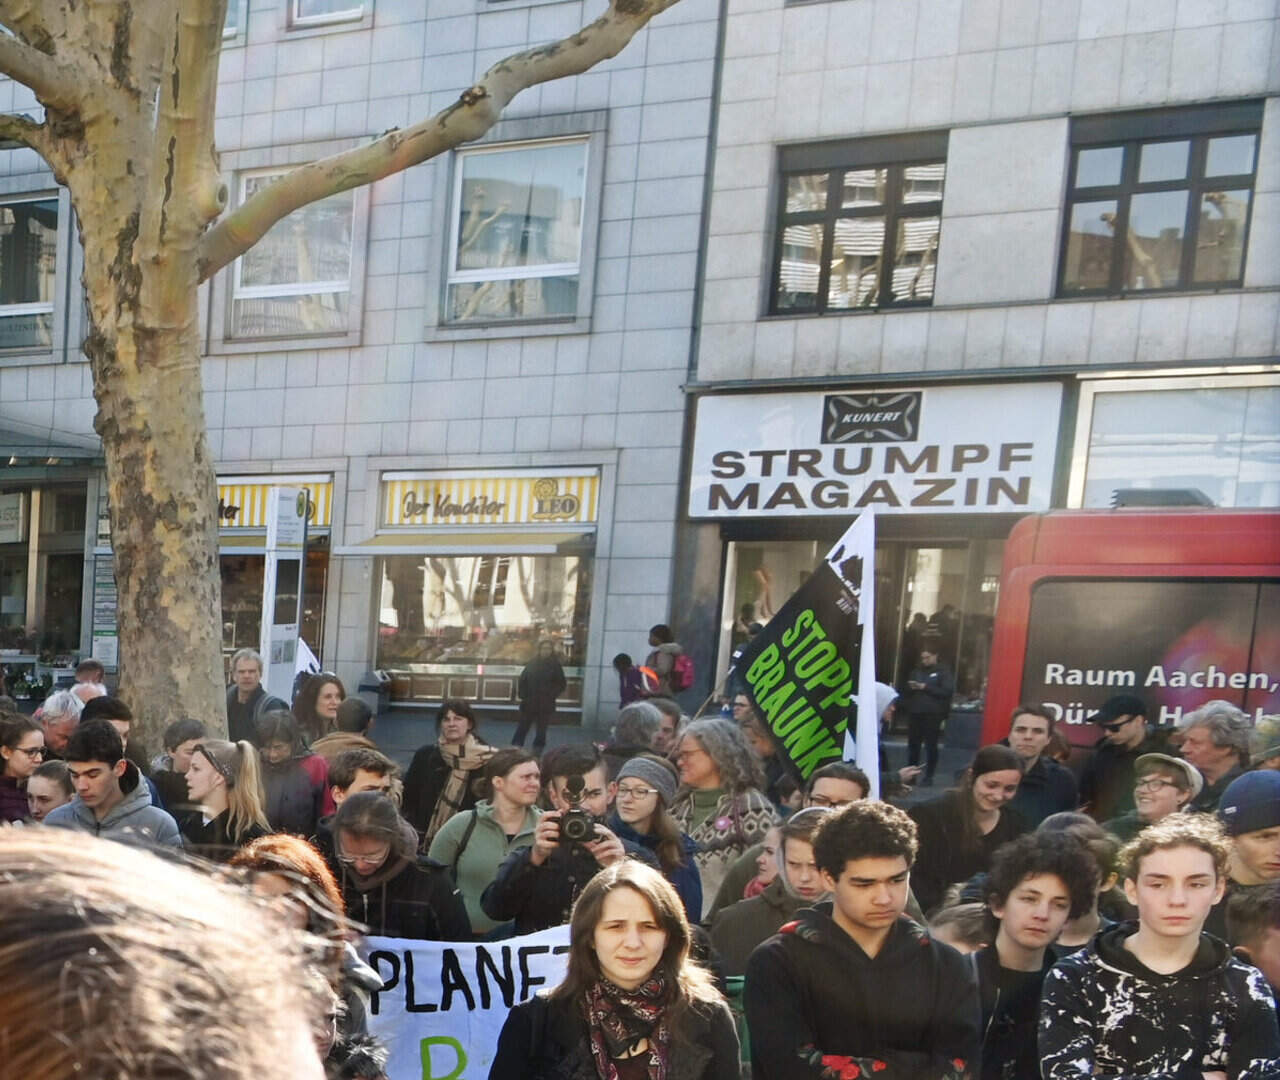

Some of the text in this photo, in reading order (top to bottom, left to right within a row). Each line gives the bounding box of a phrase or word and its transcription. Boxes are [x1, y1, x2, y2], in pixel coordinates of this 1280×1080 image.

[841, 411, 902, 424] KUNERT
[710, 442, 1034, 479] STRUMPF
[402, 491, 506, 518] Der Konditor
[537, 499, 577, 515] LEO
[707, 476, 1032, 511] MAGAZIN
[1044, 663, 1279, 692] Raum Aachen,
